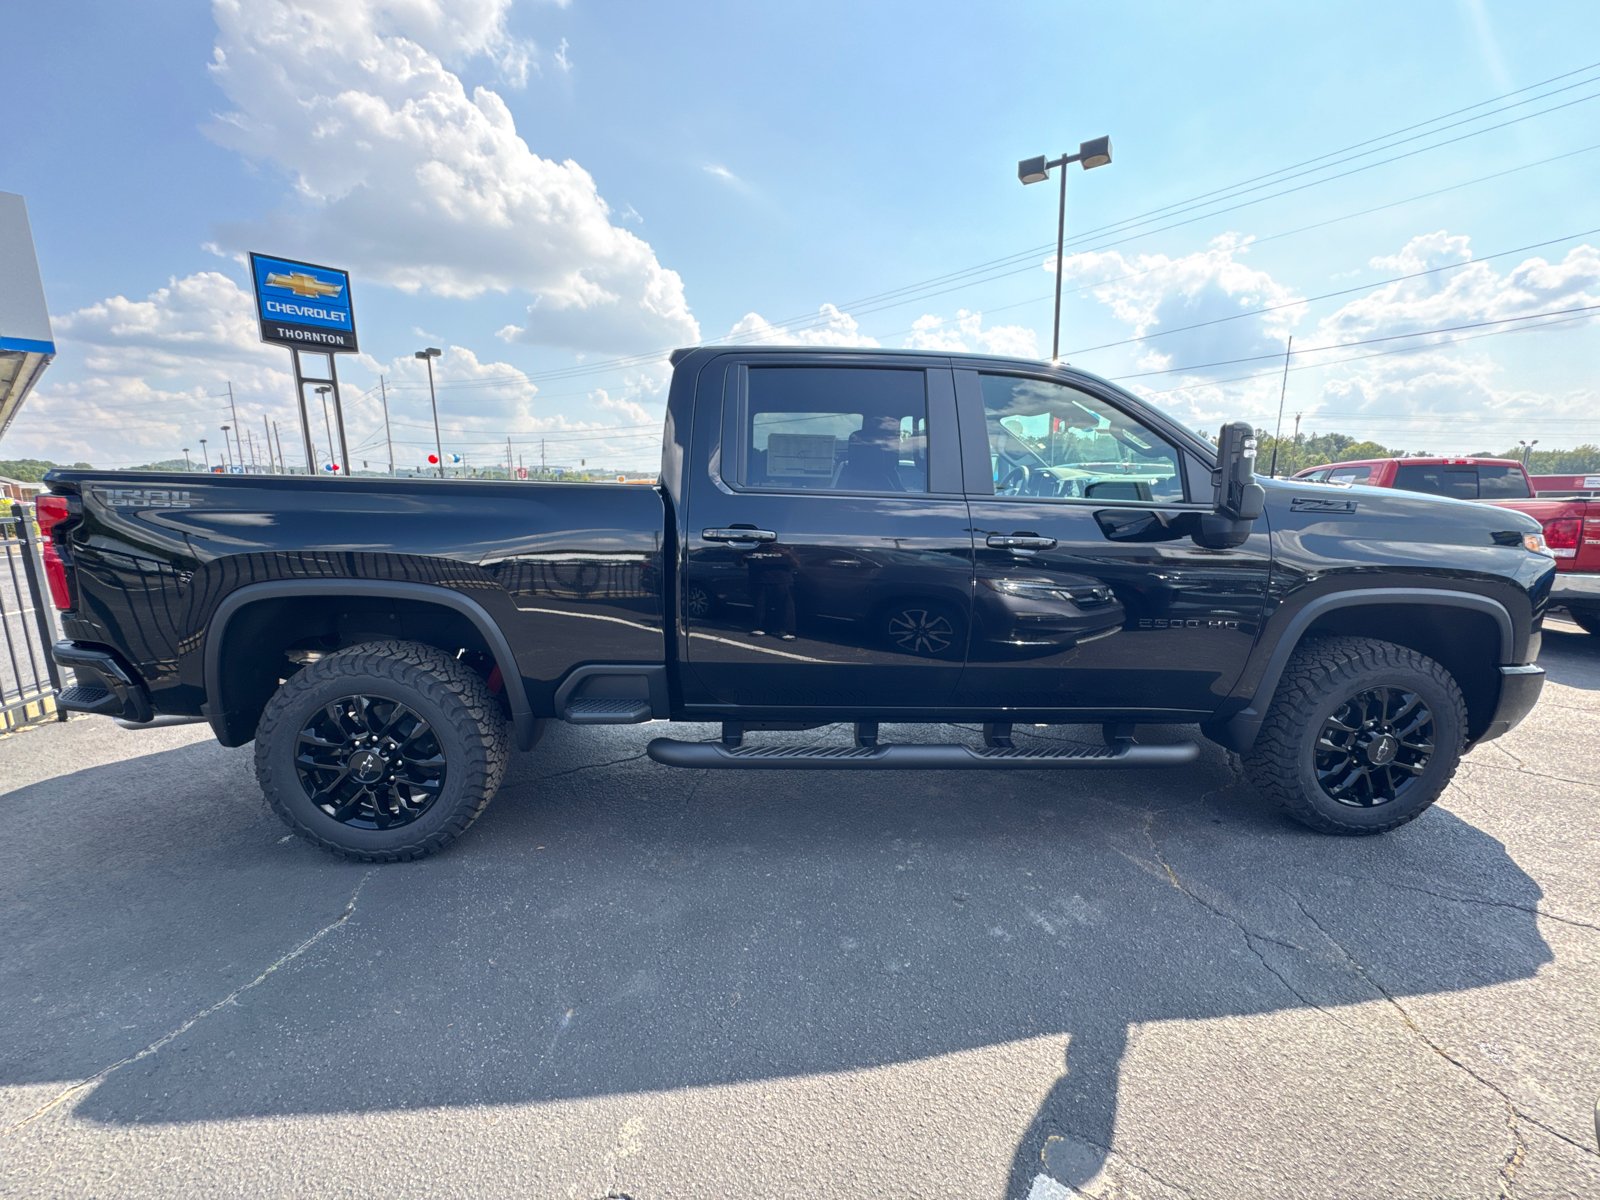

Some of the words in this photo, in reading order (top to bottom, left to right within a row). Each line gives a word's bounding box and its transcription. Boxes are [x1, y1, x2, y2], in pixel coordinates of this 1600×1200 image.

[266, 301, 347, 322] CHEVROLET
[277, 327, 345, 345] THORNTON
[92, 488, 205, 502] TRAIL
[106, 499, 191, 508] BOSS
[1139, 618, 1200, 629] 2500
[1207, 620, 1239, 631] HD
